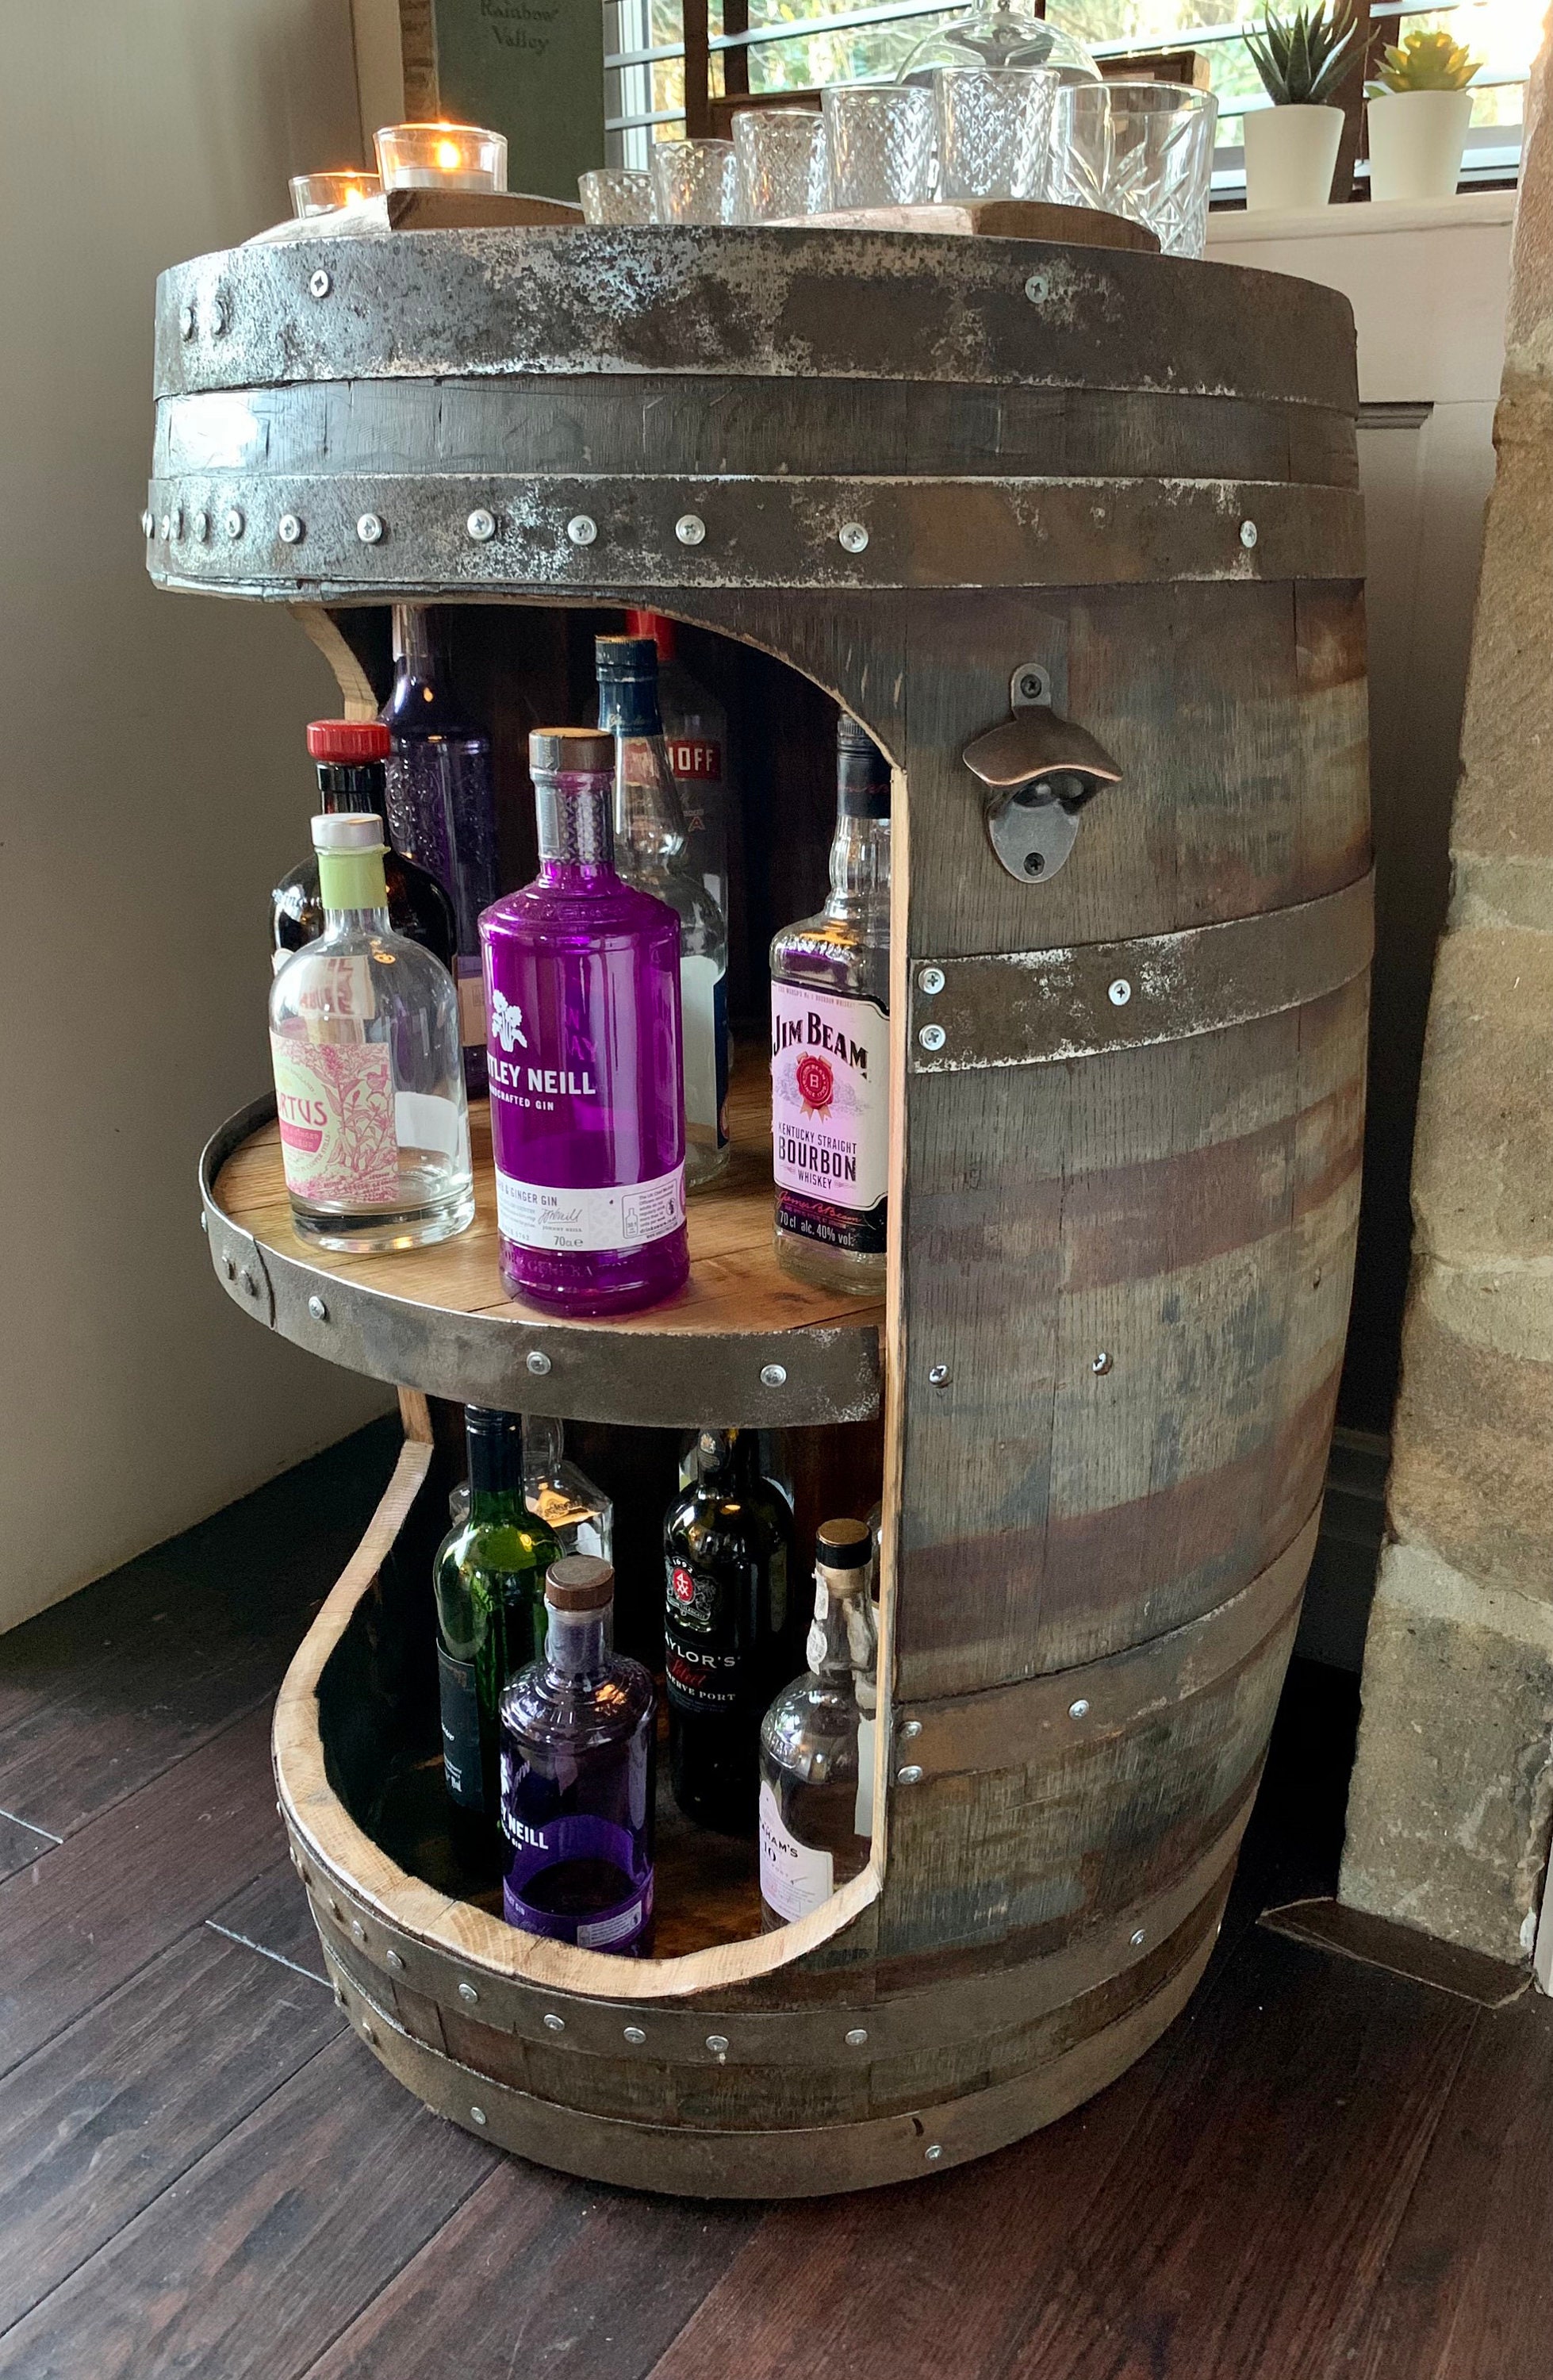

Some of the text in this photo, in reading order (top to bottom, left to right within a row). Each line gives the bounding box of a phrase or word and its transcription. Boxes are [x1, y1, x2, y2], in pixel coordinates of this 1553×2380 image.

[491, 25, 549, 55] Valley
[773, 1012, 869, 1069] JIM BEAM
[527, 1068, 596, 1095] NEILL
[535, 1101, 554, 1111] GIN
[778, 1121, 857, 1154] KENTUCKY STRAIGHT
[778, 1136, 857, 1181] BOURBON
[798, 1169, 833, 1189] WHISKEY
[511, 1188, 538, 1203] GINGER
[541, 1195, 558, 1206] GIN
[780, 1211, 788, 1226] 70
[790, 1216, 796, 1228] cl
[801, 1220, 815, 1235] alc.
[817, 1224, 836, 1242] 40%
[838, 1233, 854, 1247] vol.
[673, 1559, 693, 1574] 1692
[699, 1691, 736, 1701] PORT
[508, 1813, 549, 1849] NEILL
[764, 1841, 776, 1861] 10
